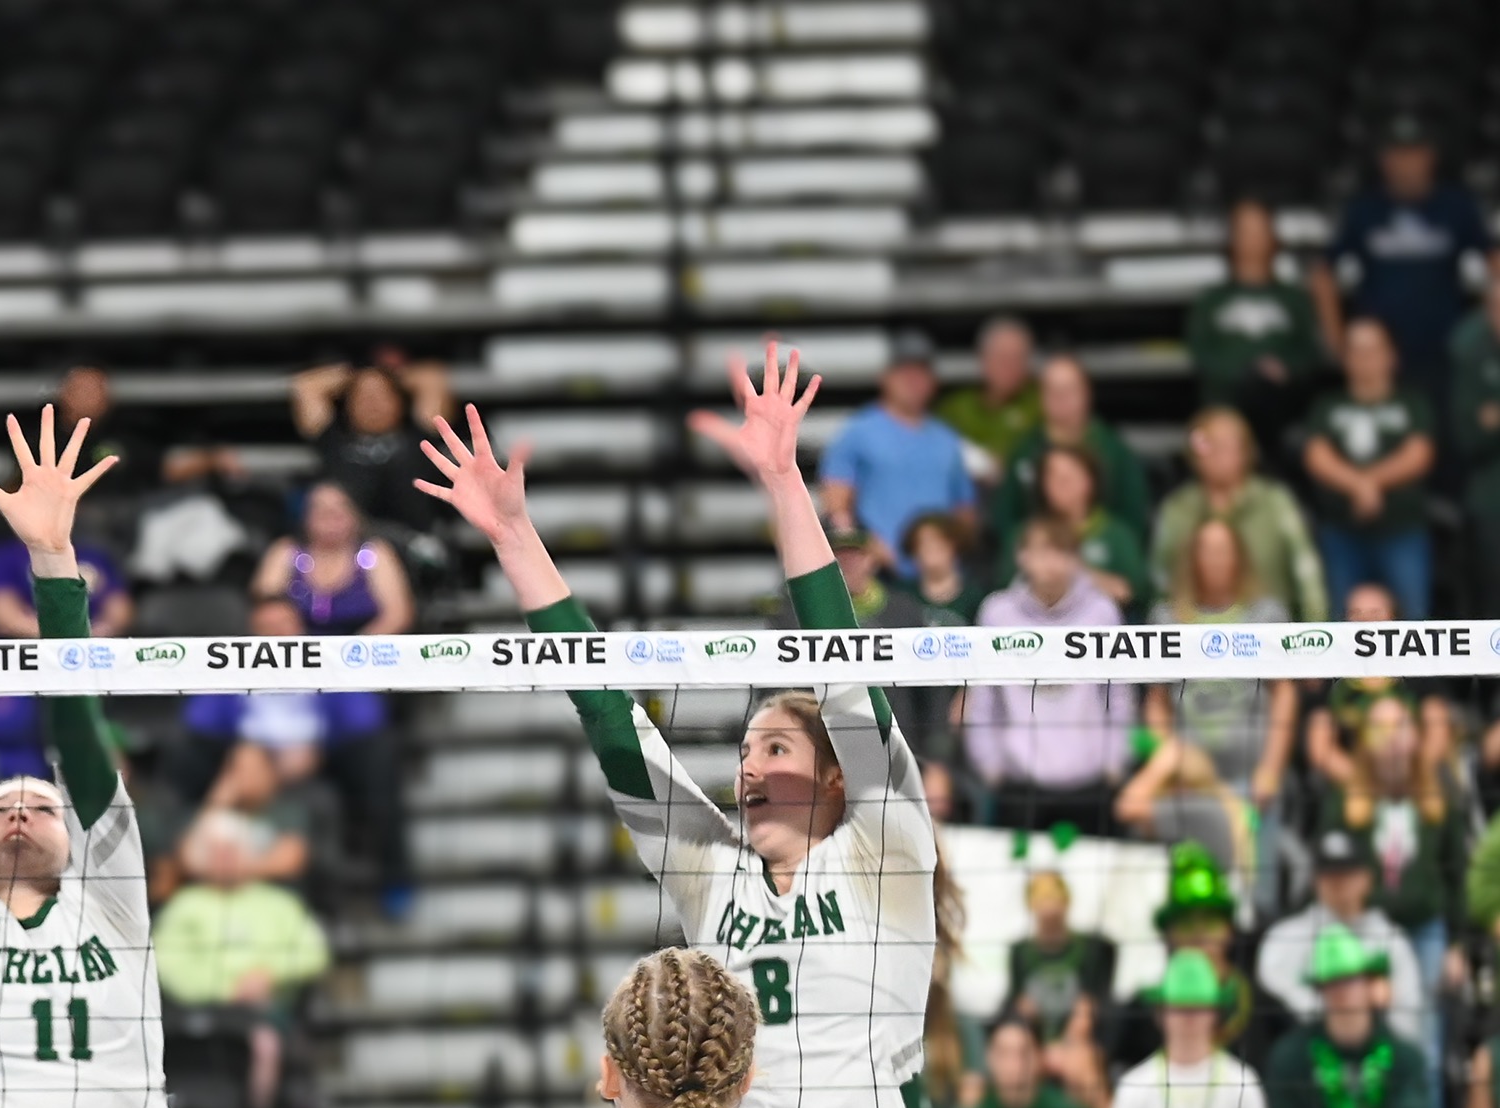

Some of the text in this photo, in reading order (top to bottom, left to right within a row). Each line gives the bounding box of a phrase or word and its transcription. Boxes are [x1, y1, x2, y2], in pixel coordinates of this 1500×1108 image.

[777, 634, 894, 662] STATE
[944, 641, 972, 650] Credit
[1064, 631, 1182, 659] STATE
[1232, 631, 1255, 640] Gesa
[1232, 639, 1261, 649] Credit
[1354, 628, 1471, 657] STATE
[207, 641, 322, 669] STATE
[492, 637, 606, 666] STATE
[944, 649, 970, 658] Union
[1232, 648, 1258, 657] Union
[716, 889, 846, 953] CHEAN
[752, 956, 793, 1025] 8
[31, 997, 93, 1062] 11
